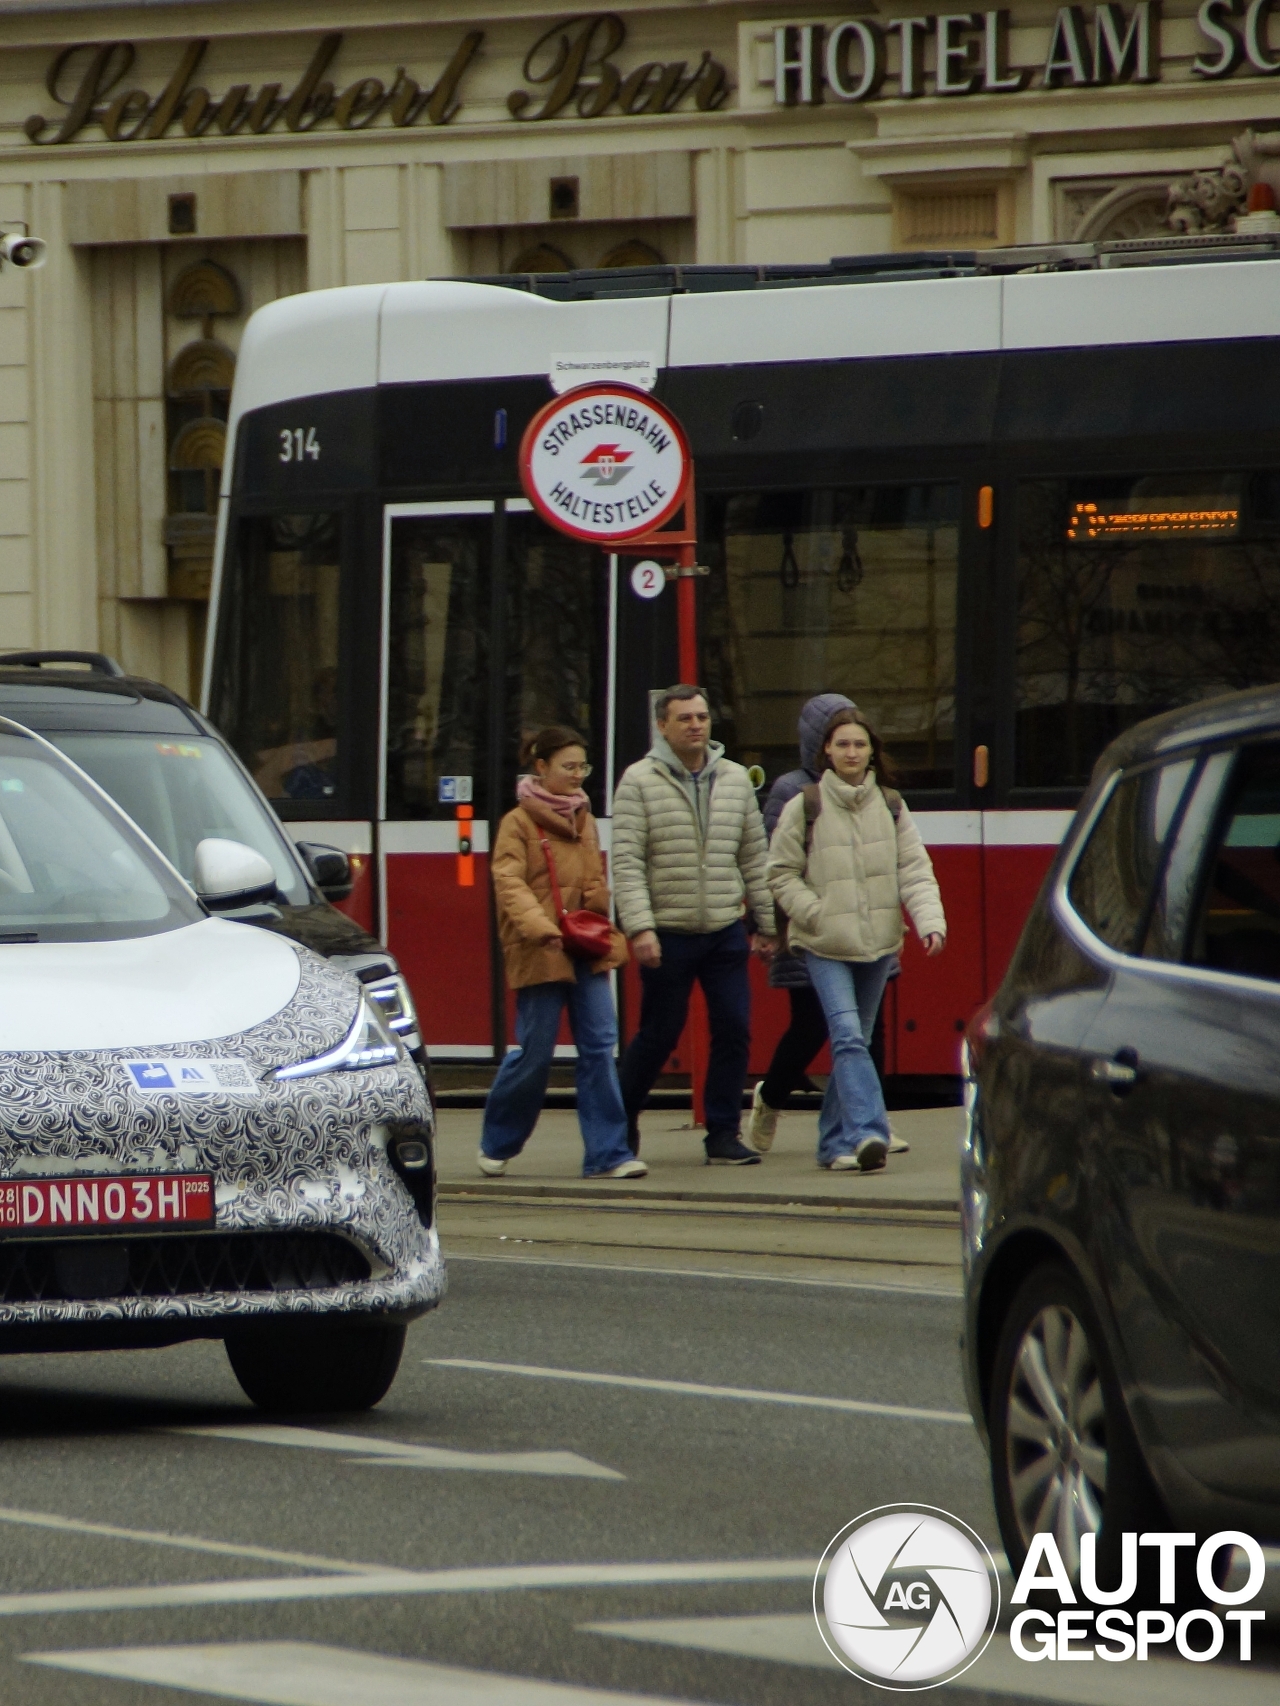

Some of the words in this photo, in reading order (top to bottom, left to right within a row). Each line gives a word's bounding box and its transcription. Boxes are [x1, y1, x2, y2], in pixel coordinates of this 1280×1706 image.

[773, 9, 1032, 106] HOTEL
[1042, 1, 1157, 85] AM
[23, 30, 476, 146] Schubert
[506, 12, 738, 121] Bar
[279, 427, 320, 462] 314
[543, 404, 671, 456] STRASSENBAHN
[549, 479, 666, 524] HALTESTELLE
[641, 569, 655, 589] 2
[22, 1180, 180, 1223] DNN03H
[185, 1181, 210, 1193] 2025
